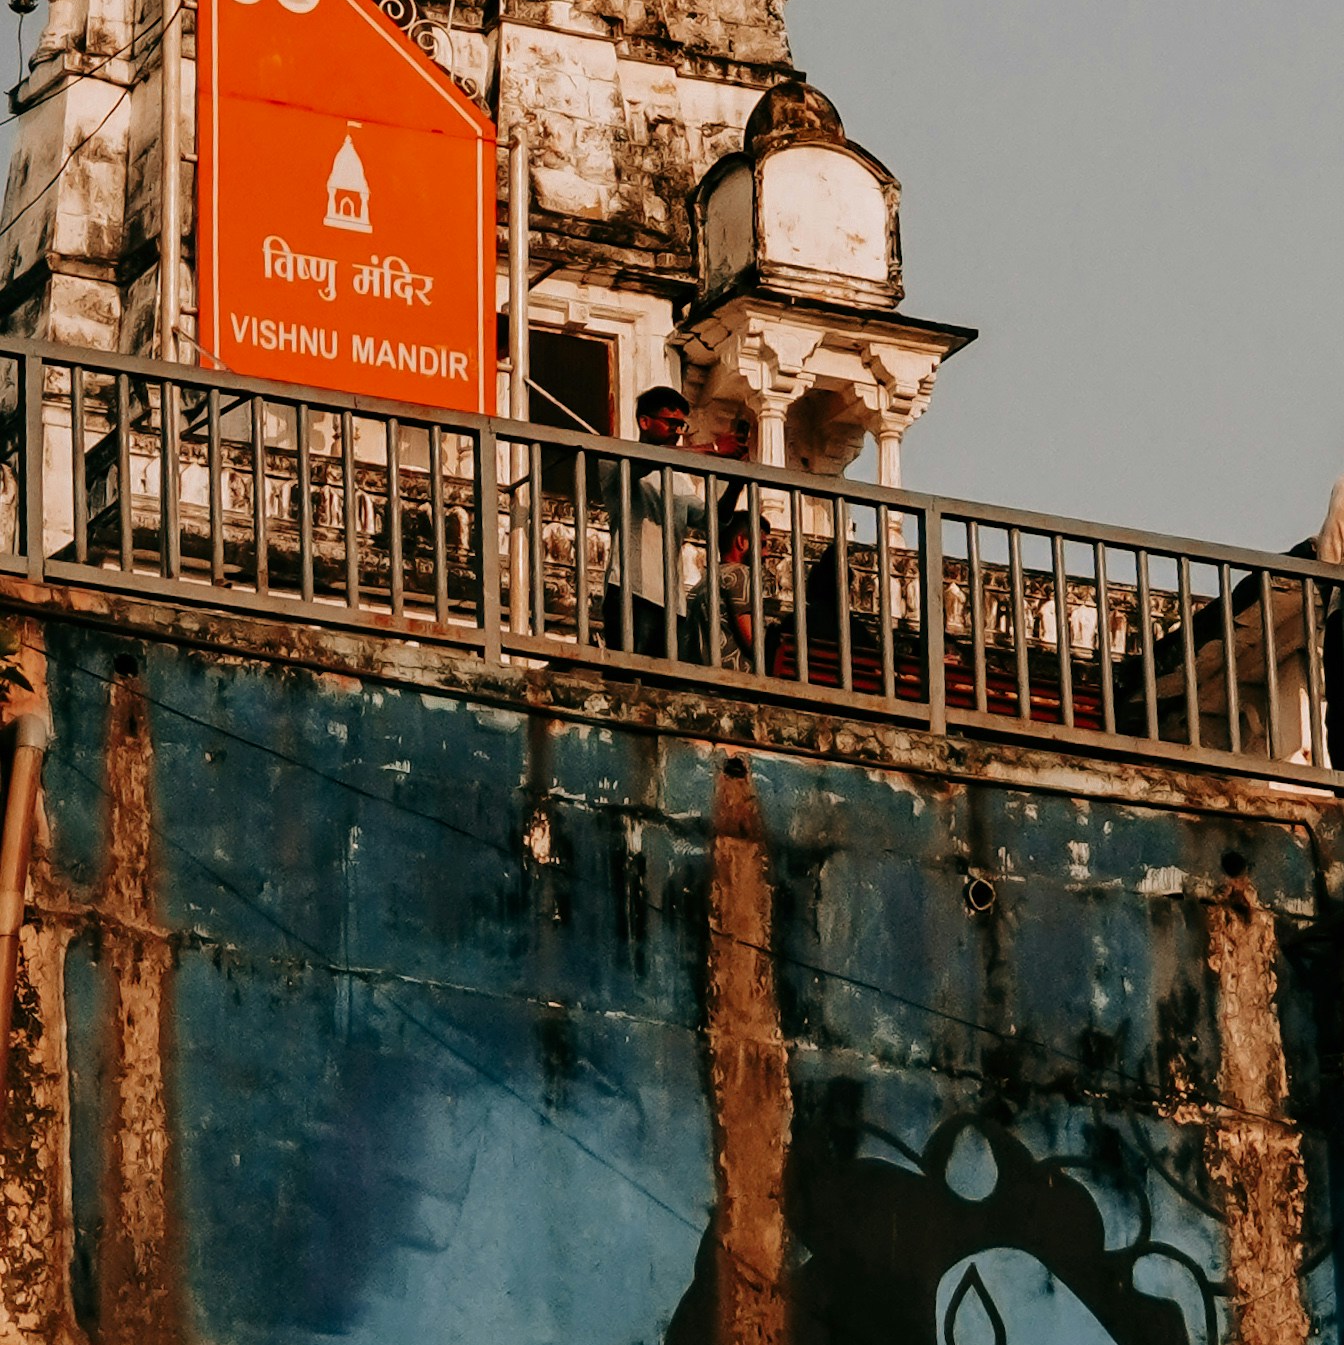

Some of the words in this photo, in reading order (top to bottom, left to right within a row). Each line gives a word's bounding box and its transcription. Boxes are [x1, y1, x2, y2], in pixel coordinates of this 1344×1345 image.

[262, 235, 338, 302] विष्णु
[352, 254, 434, 306] मंदिर
[230, 312, 338, 360] VISHNU
[352, 334, 469, 382] MANDIR
